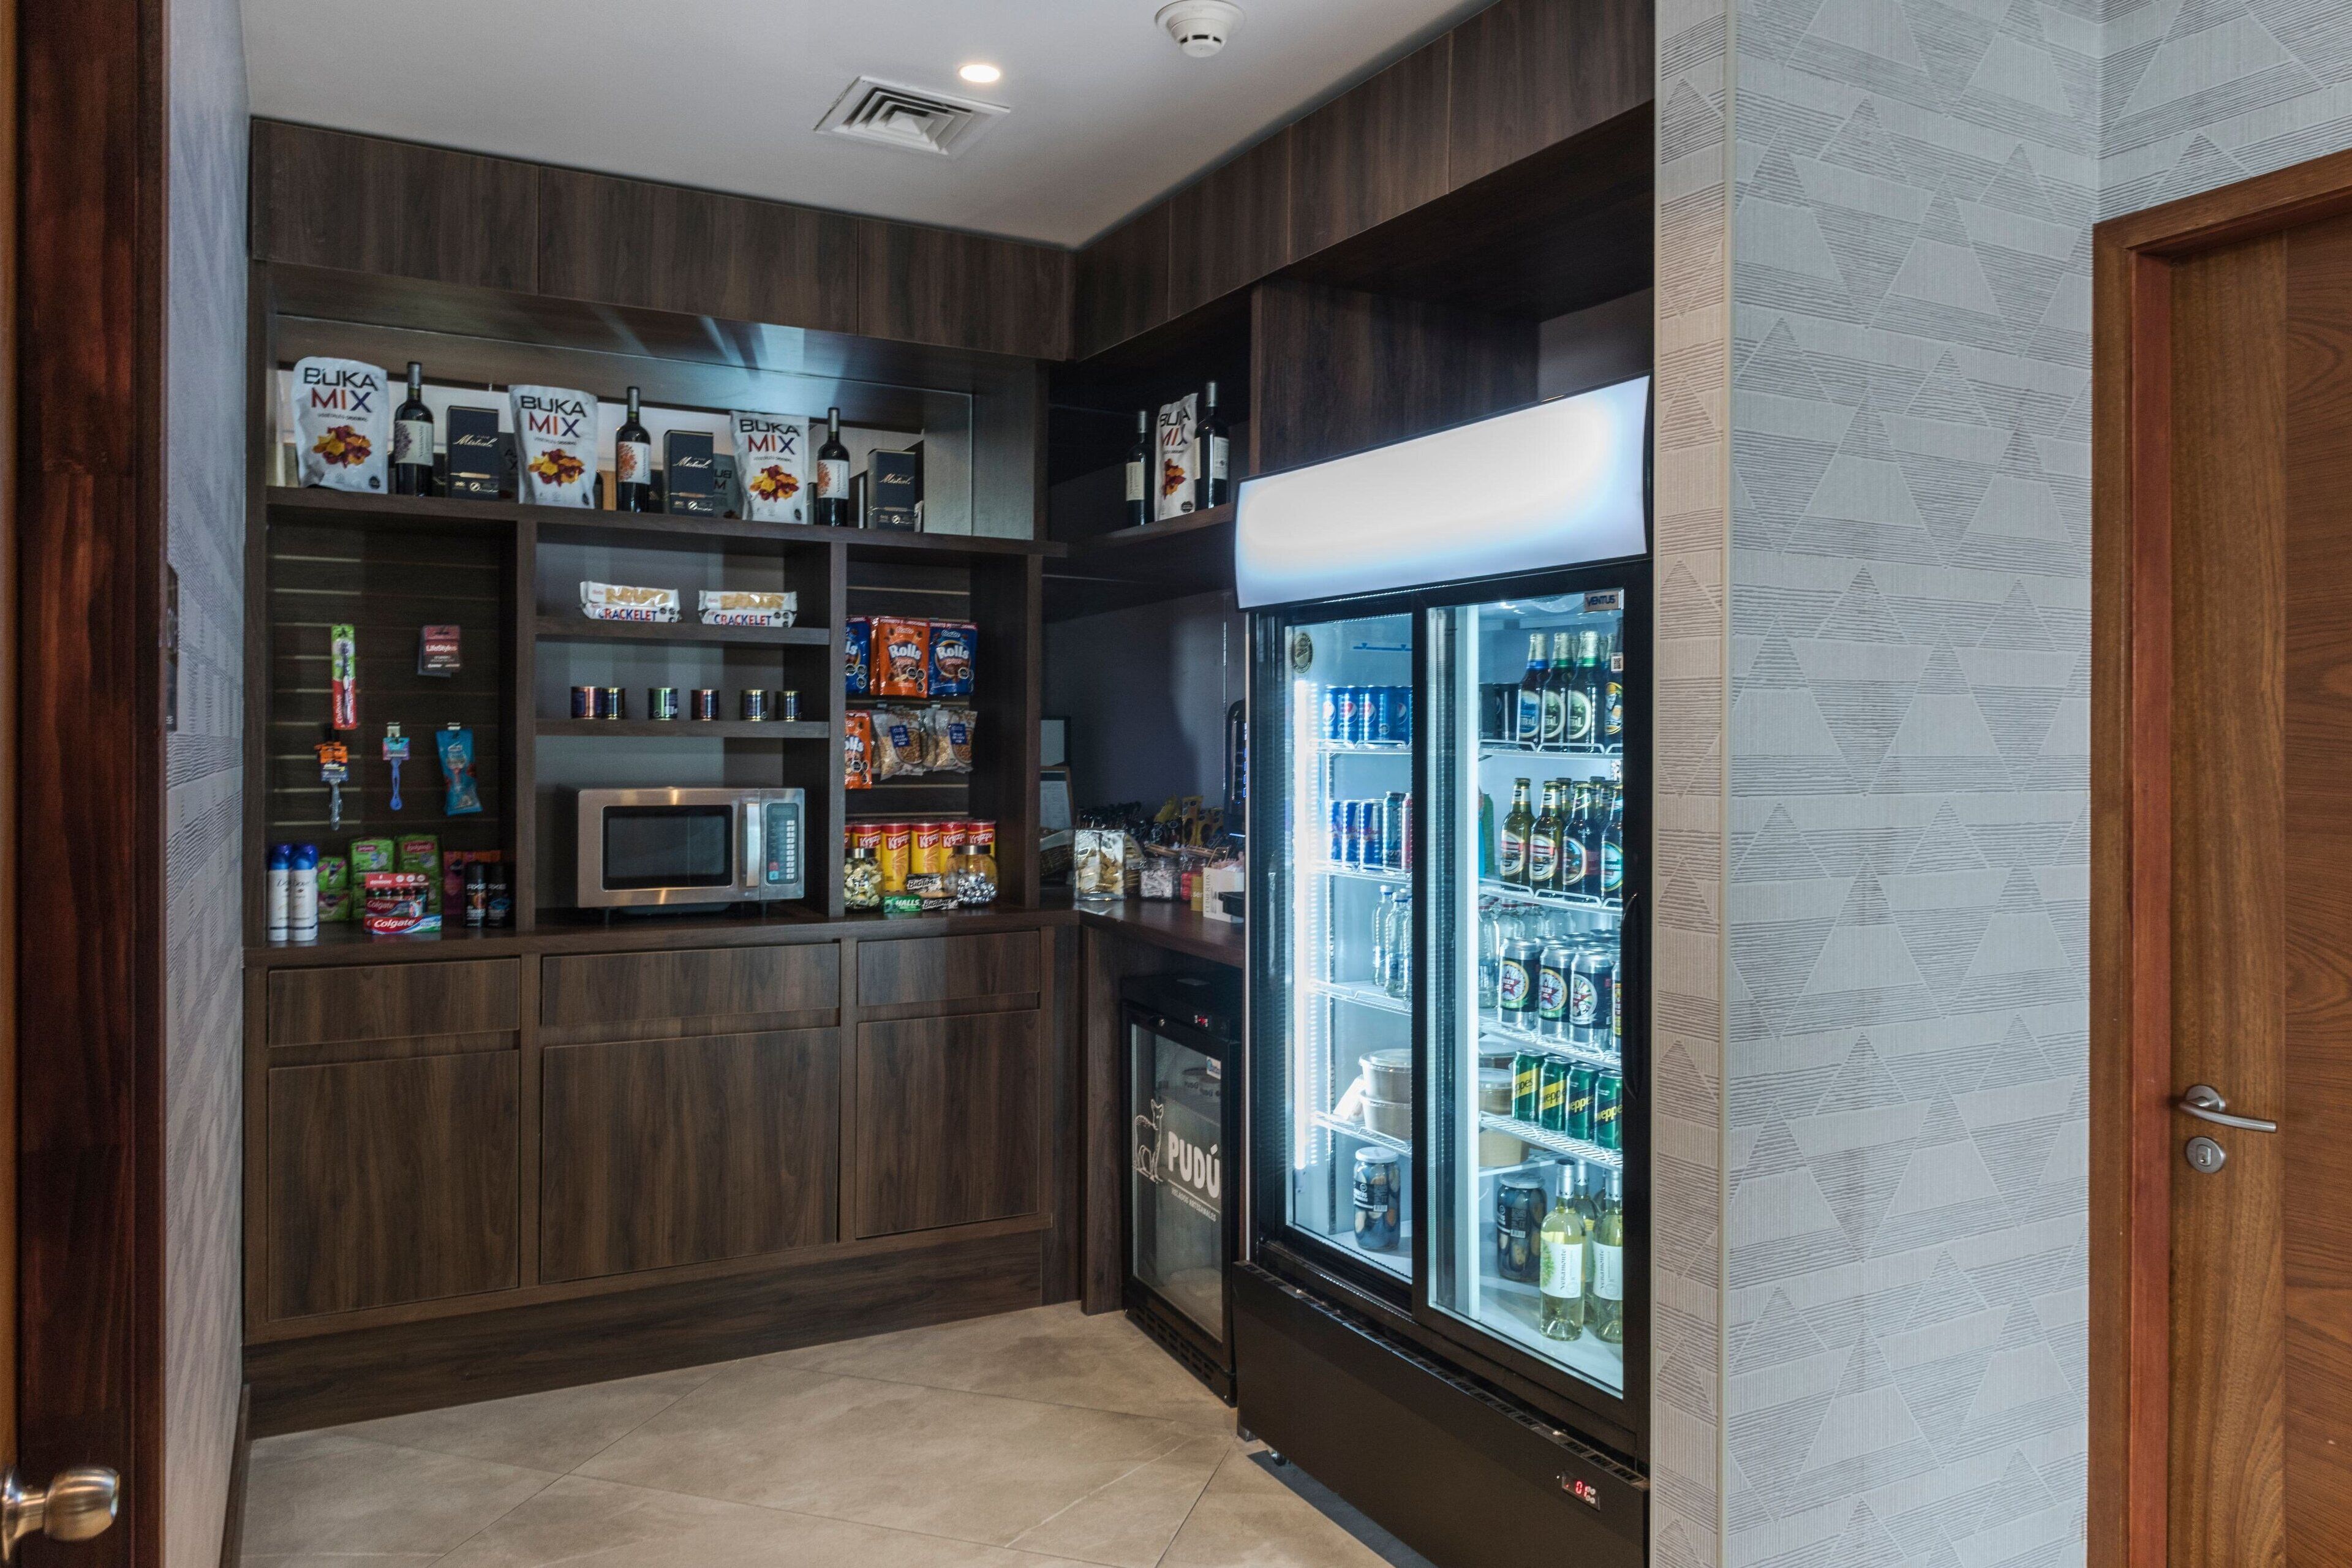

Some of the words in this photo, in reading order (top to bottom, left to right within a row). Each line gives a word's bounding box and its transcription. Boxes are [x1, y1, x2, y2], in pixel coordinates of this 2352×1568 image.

[304, 368, 379, 391] BUKA
[311, 388, 372, 413] MIX
[521, 396, 587, 418] BUKA
[529, 412, 581, 438] MIX
[739, 419, 801, 437] BUKA
[748, 434, 796, 454] MIX
[598, 608, 658, 621] CRACKELET
[714, 614, 772, 625] CRACKELET
[888, 644, 922, 660] Rolls
[937, 645, 970, 660] Rolls
[374, 918, 417, 929] Colgate
[1168, 1131, 1220, 1199] PUDÚ
